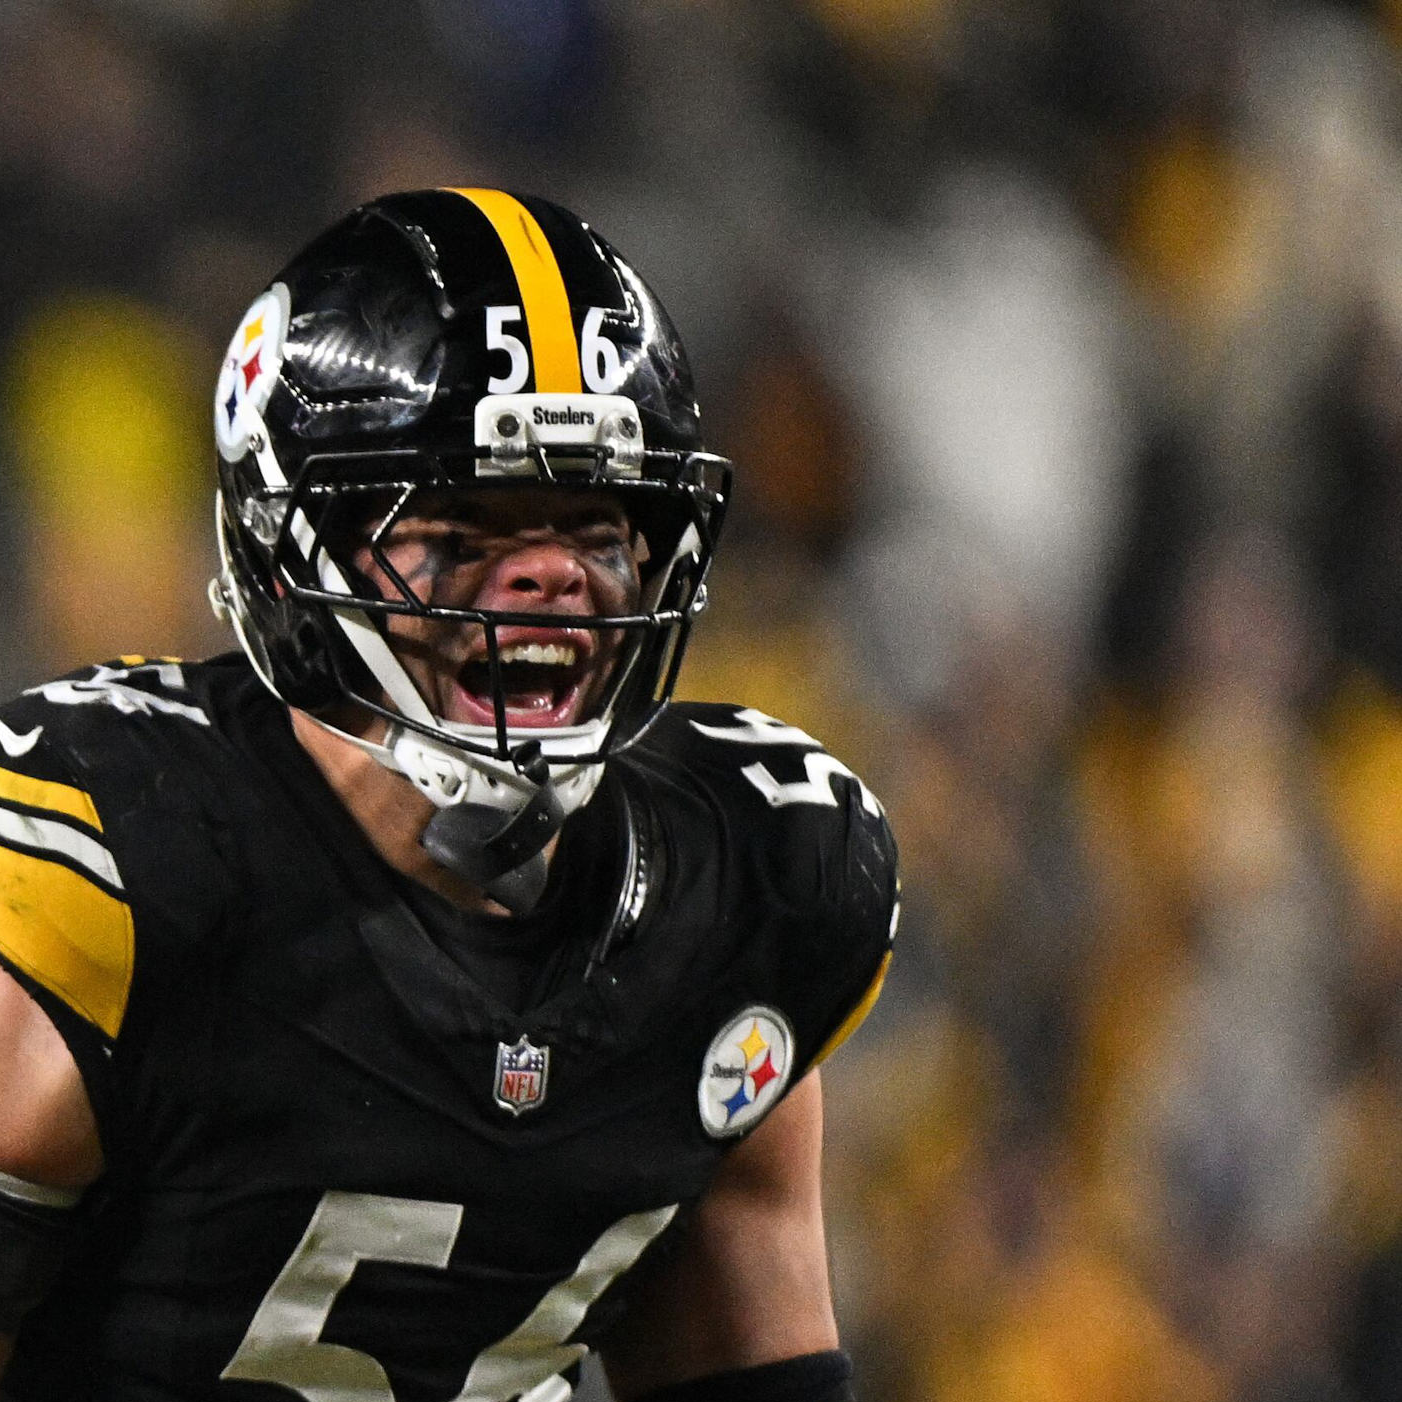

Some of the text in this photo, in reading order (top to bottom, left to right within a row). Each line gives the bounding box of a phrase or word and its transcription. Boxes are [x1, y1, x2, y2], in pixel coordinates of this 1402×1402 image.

[486, 304, 620, 395] 56
[533, 406, 594, 425] Steelers
[503, 1072, 539, 1101] NFL
